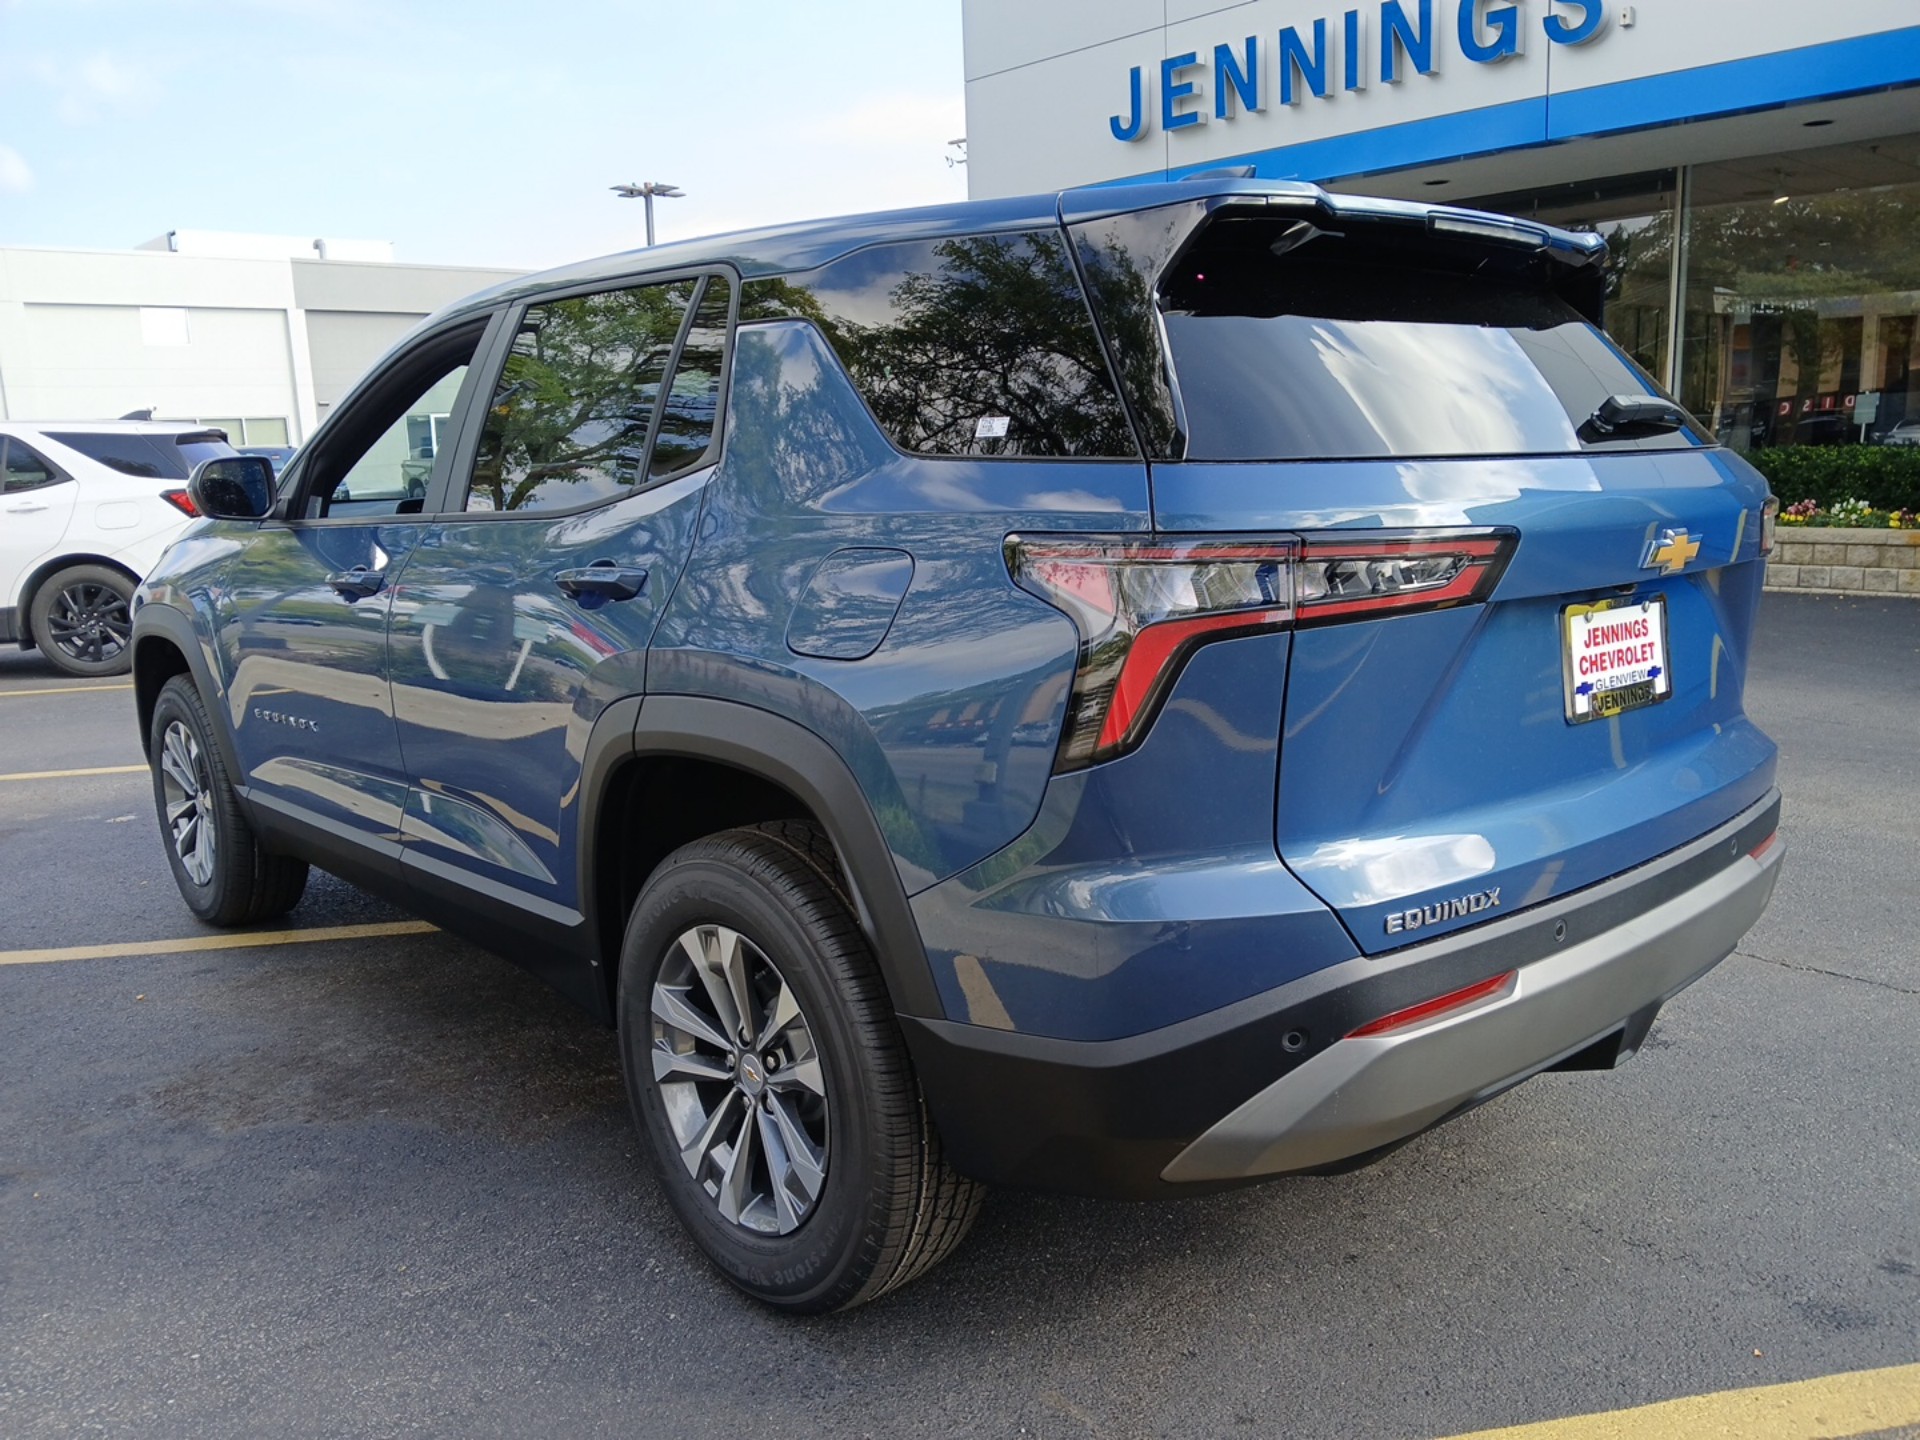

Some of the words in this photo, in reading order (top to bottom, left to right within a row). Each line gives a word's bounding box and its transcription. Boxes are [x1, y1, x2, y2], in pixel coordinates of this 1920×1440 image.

[1109, 0, 1605, 142] JENNINGS
[1584, 618, 1649, 649] JENNINGS
[1579, 642, 1655, 676] CHEVROLET
[1595, 669, 1647, 692] GLENVIEW
[1597, 686, 1651, 711] JENNINGS
[1385, 886, 1500, 934] EQUINOX
